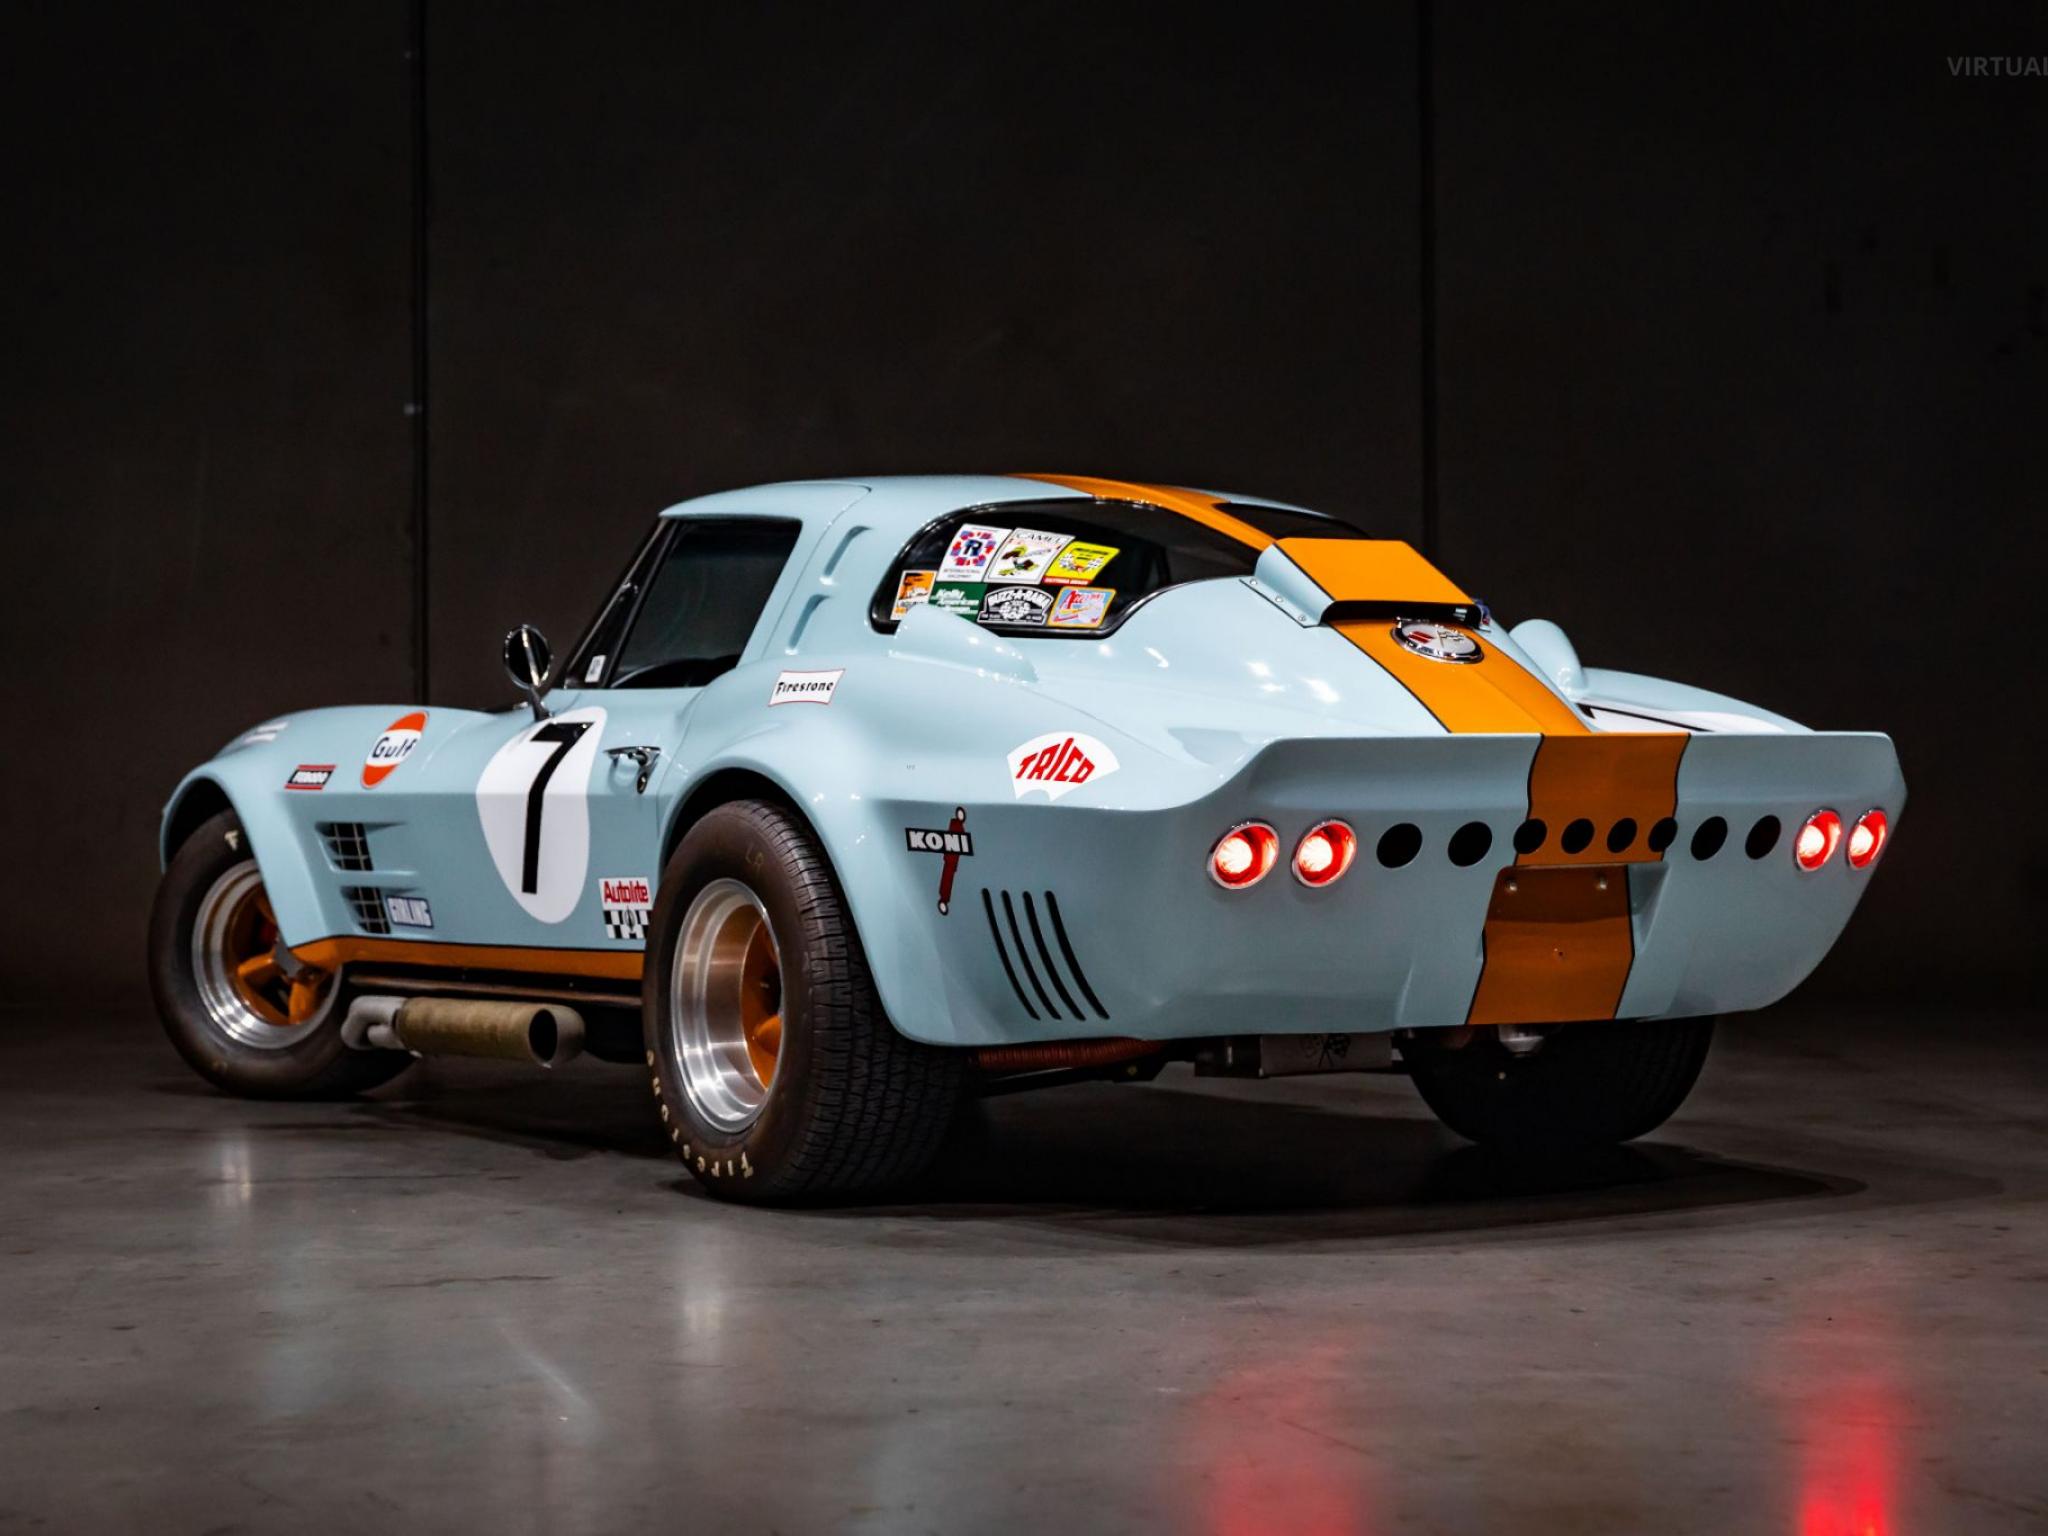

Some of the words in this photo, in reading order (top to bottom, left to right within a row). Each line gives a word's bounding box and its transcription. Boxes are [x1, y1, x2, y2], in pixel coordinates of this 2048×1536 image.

[775, 681, 834, 696] Firestone
[372, 736, 417, 758] Gulf
[1015, 737, 1096, 784] TRICO
[522, 721, 594, 895] 7
[908, 830, 970, 853] KONI
[604, 880, 649, 904] Autolite
